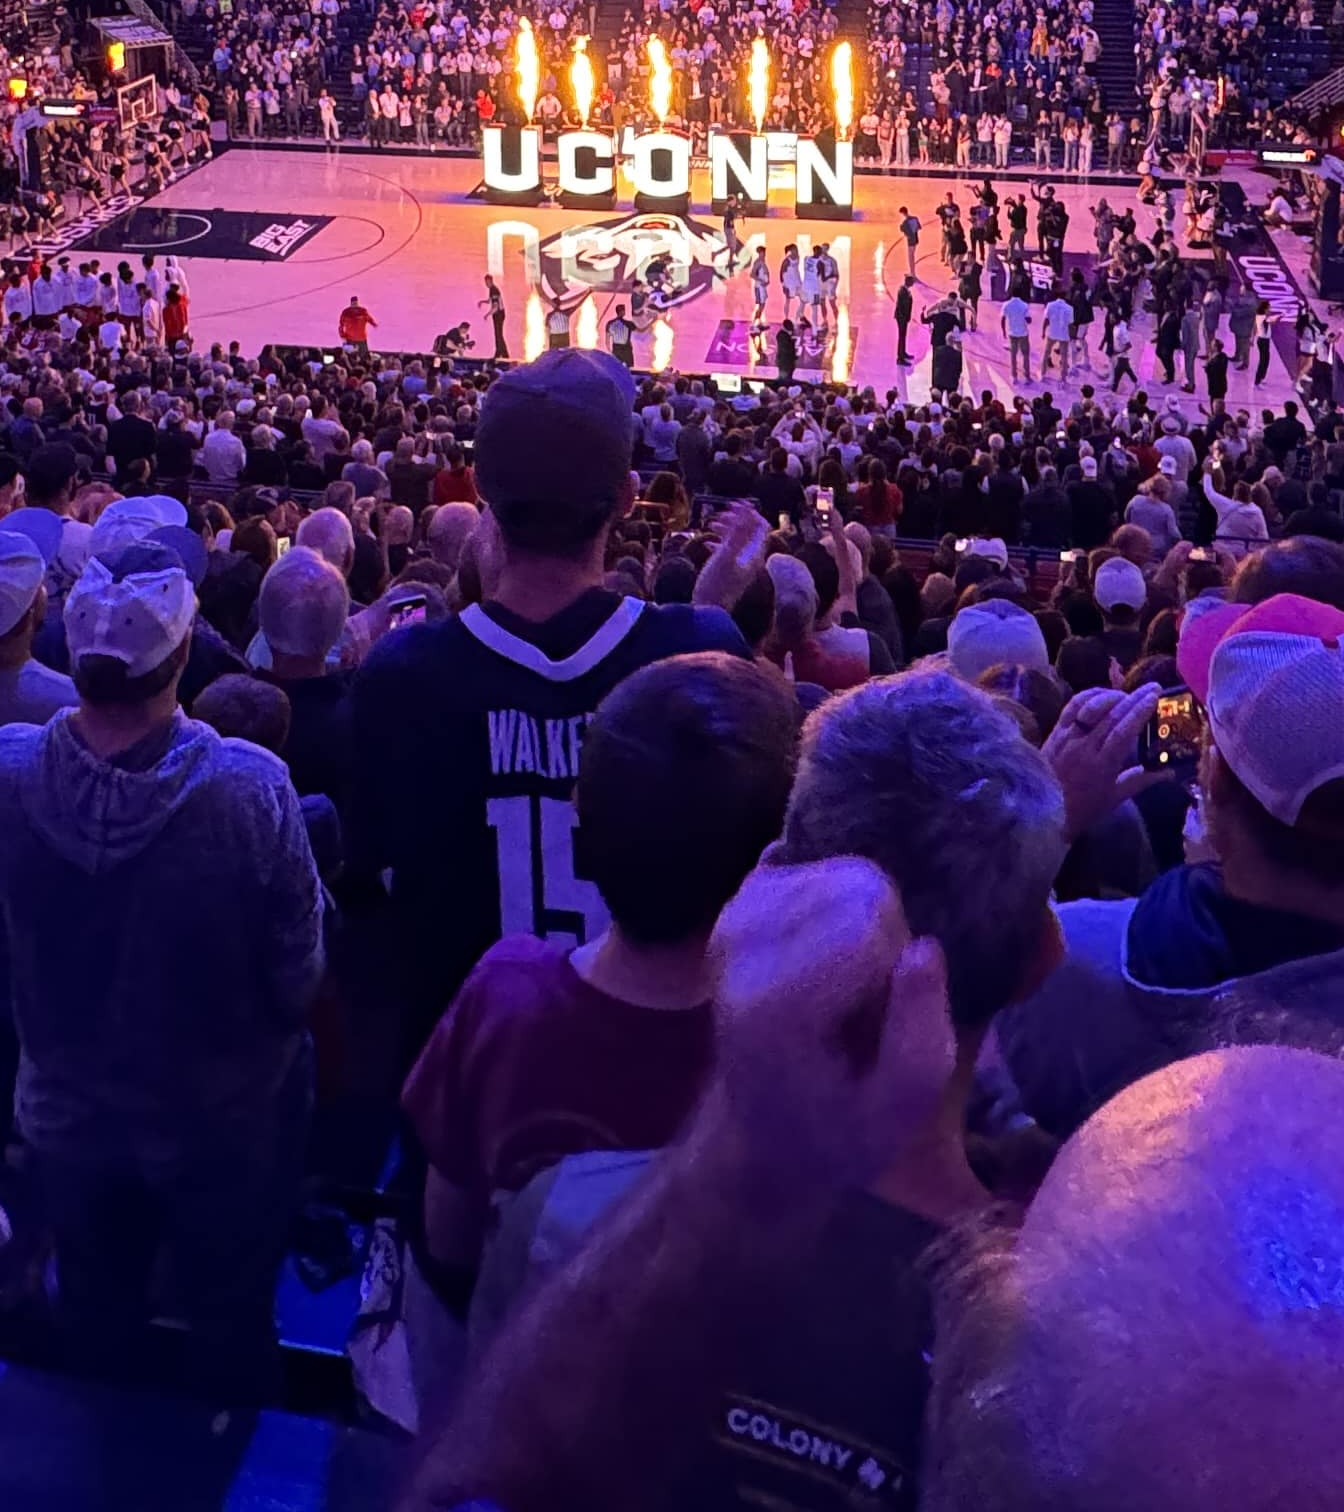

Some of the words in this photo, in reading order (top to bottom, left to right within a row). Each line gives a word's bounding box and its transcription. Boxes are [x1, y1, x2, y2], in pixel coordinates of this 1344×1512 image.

[483, 126, 854, 207] UCONN
[249, 223, 287, 248] BIG
[264, 219, 311, 255] EAST
[488, 709, 594, 779] WALKE
[728, 1408, 853, 1471] COLONY
